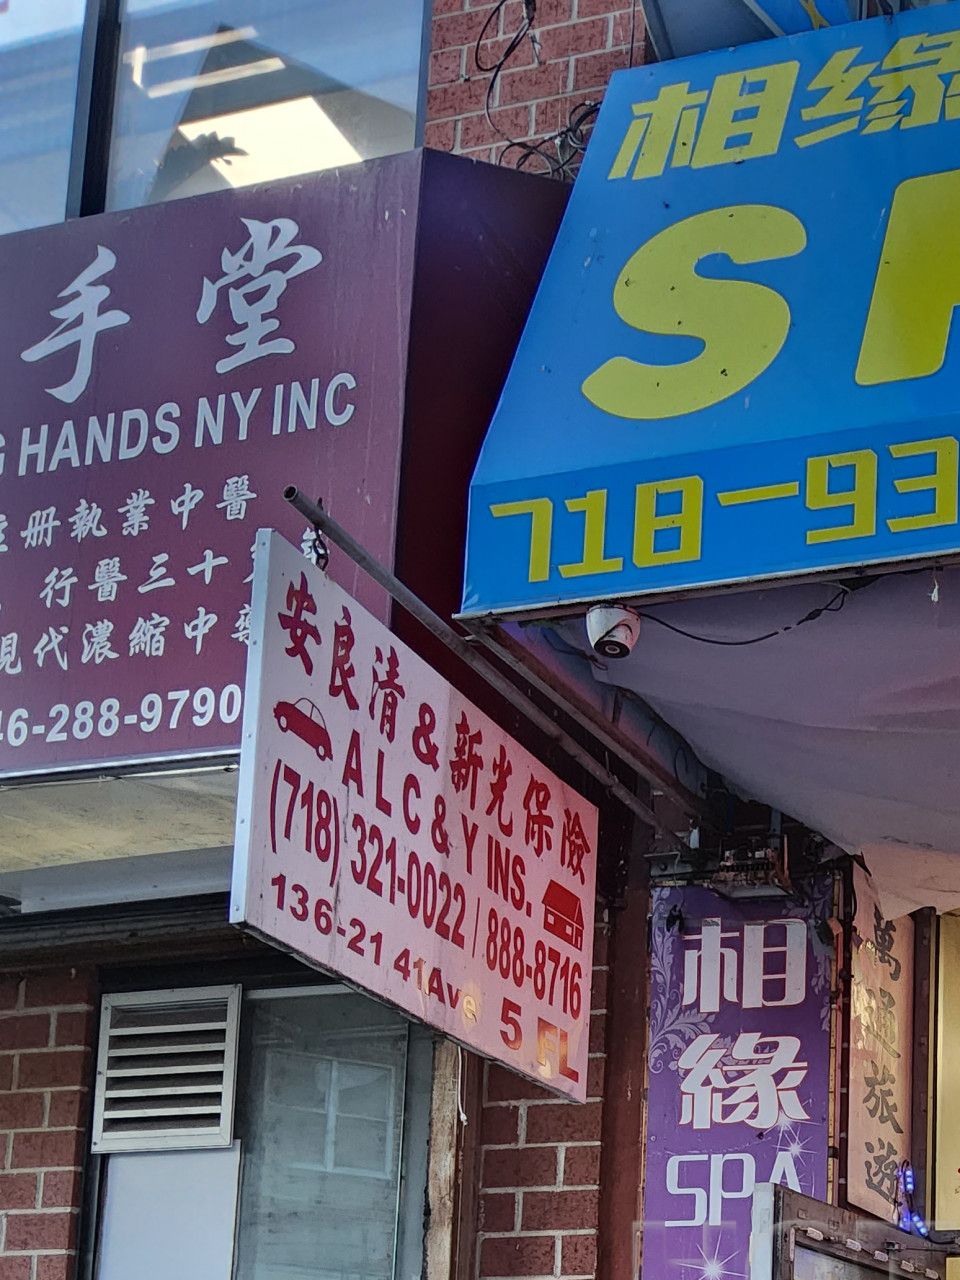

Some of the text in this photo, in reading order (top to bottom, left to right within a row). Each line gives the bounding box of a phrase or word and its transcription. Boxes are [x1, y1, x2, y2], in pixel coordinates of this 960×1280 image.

[18, 402, 180, 477] HANDS
[194, 387, 261, 449] NY
[272, 372, 356, 436] INC
[0, 684, 242, 746] 6-288-9790
[278, 571, 591, 886] 安良清 & 新光保險
[270, 759, 583, 1020] (718) 321-0022 888-8716
[431, 794, 450, 859] &
[461, 812, 479, 876] Y
[487, 833, 532, 918] INS.
[271, 873, 383, 966] 136-21
[500, 997, 522, 1051] 5
[537, 1016, 579, 1084] FL
[677, 917, 811, 1129] 相緣
[665, 1152, 804, 1228] SPA
